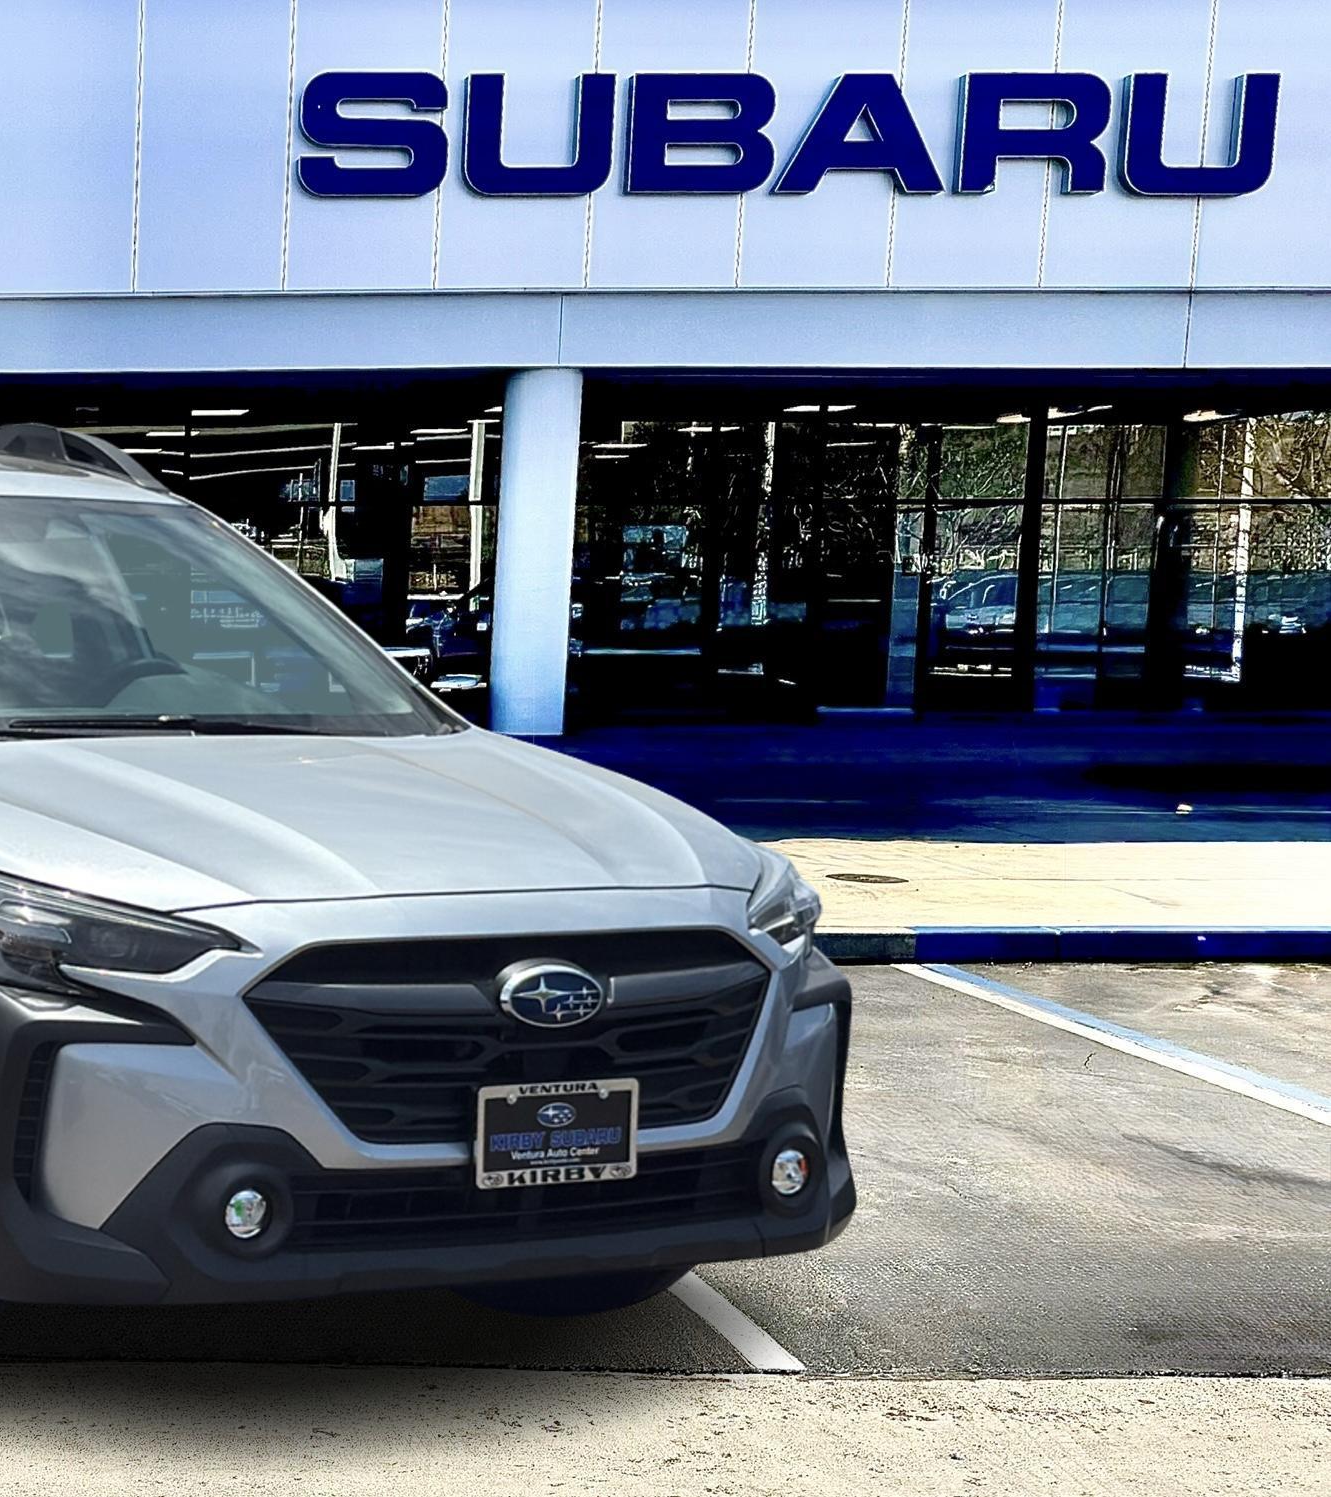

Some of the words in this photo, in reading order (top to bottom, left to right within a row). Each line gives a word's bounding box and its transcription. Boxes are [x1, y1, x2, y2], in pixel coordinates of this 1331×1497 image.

[297, 71, 1282, 198] SUBARU
[518, 1082, 599, 1095] VENTURA
[490, 1131, 546, 1152] KIRBY
[549, 1127, 622, 1148] SUBARU
[510, 1149, 545, 1160] Ventura
[547, 1148, 569, 1158] Auto
[570, 1146, 600, 1157] Center
[507, 1166, 606, 1186] KIRBY
